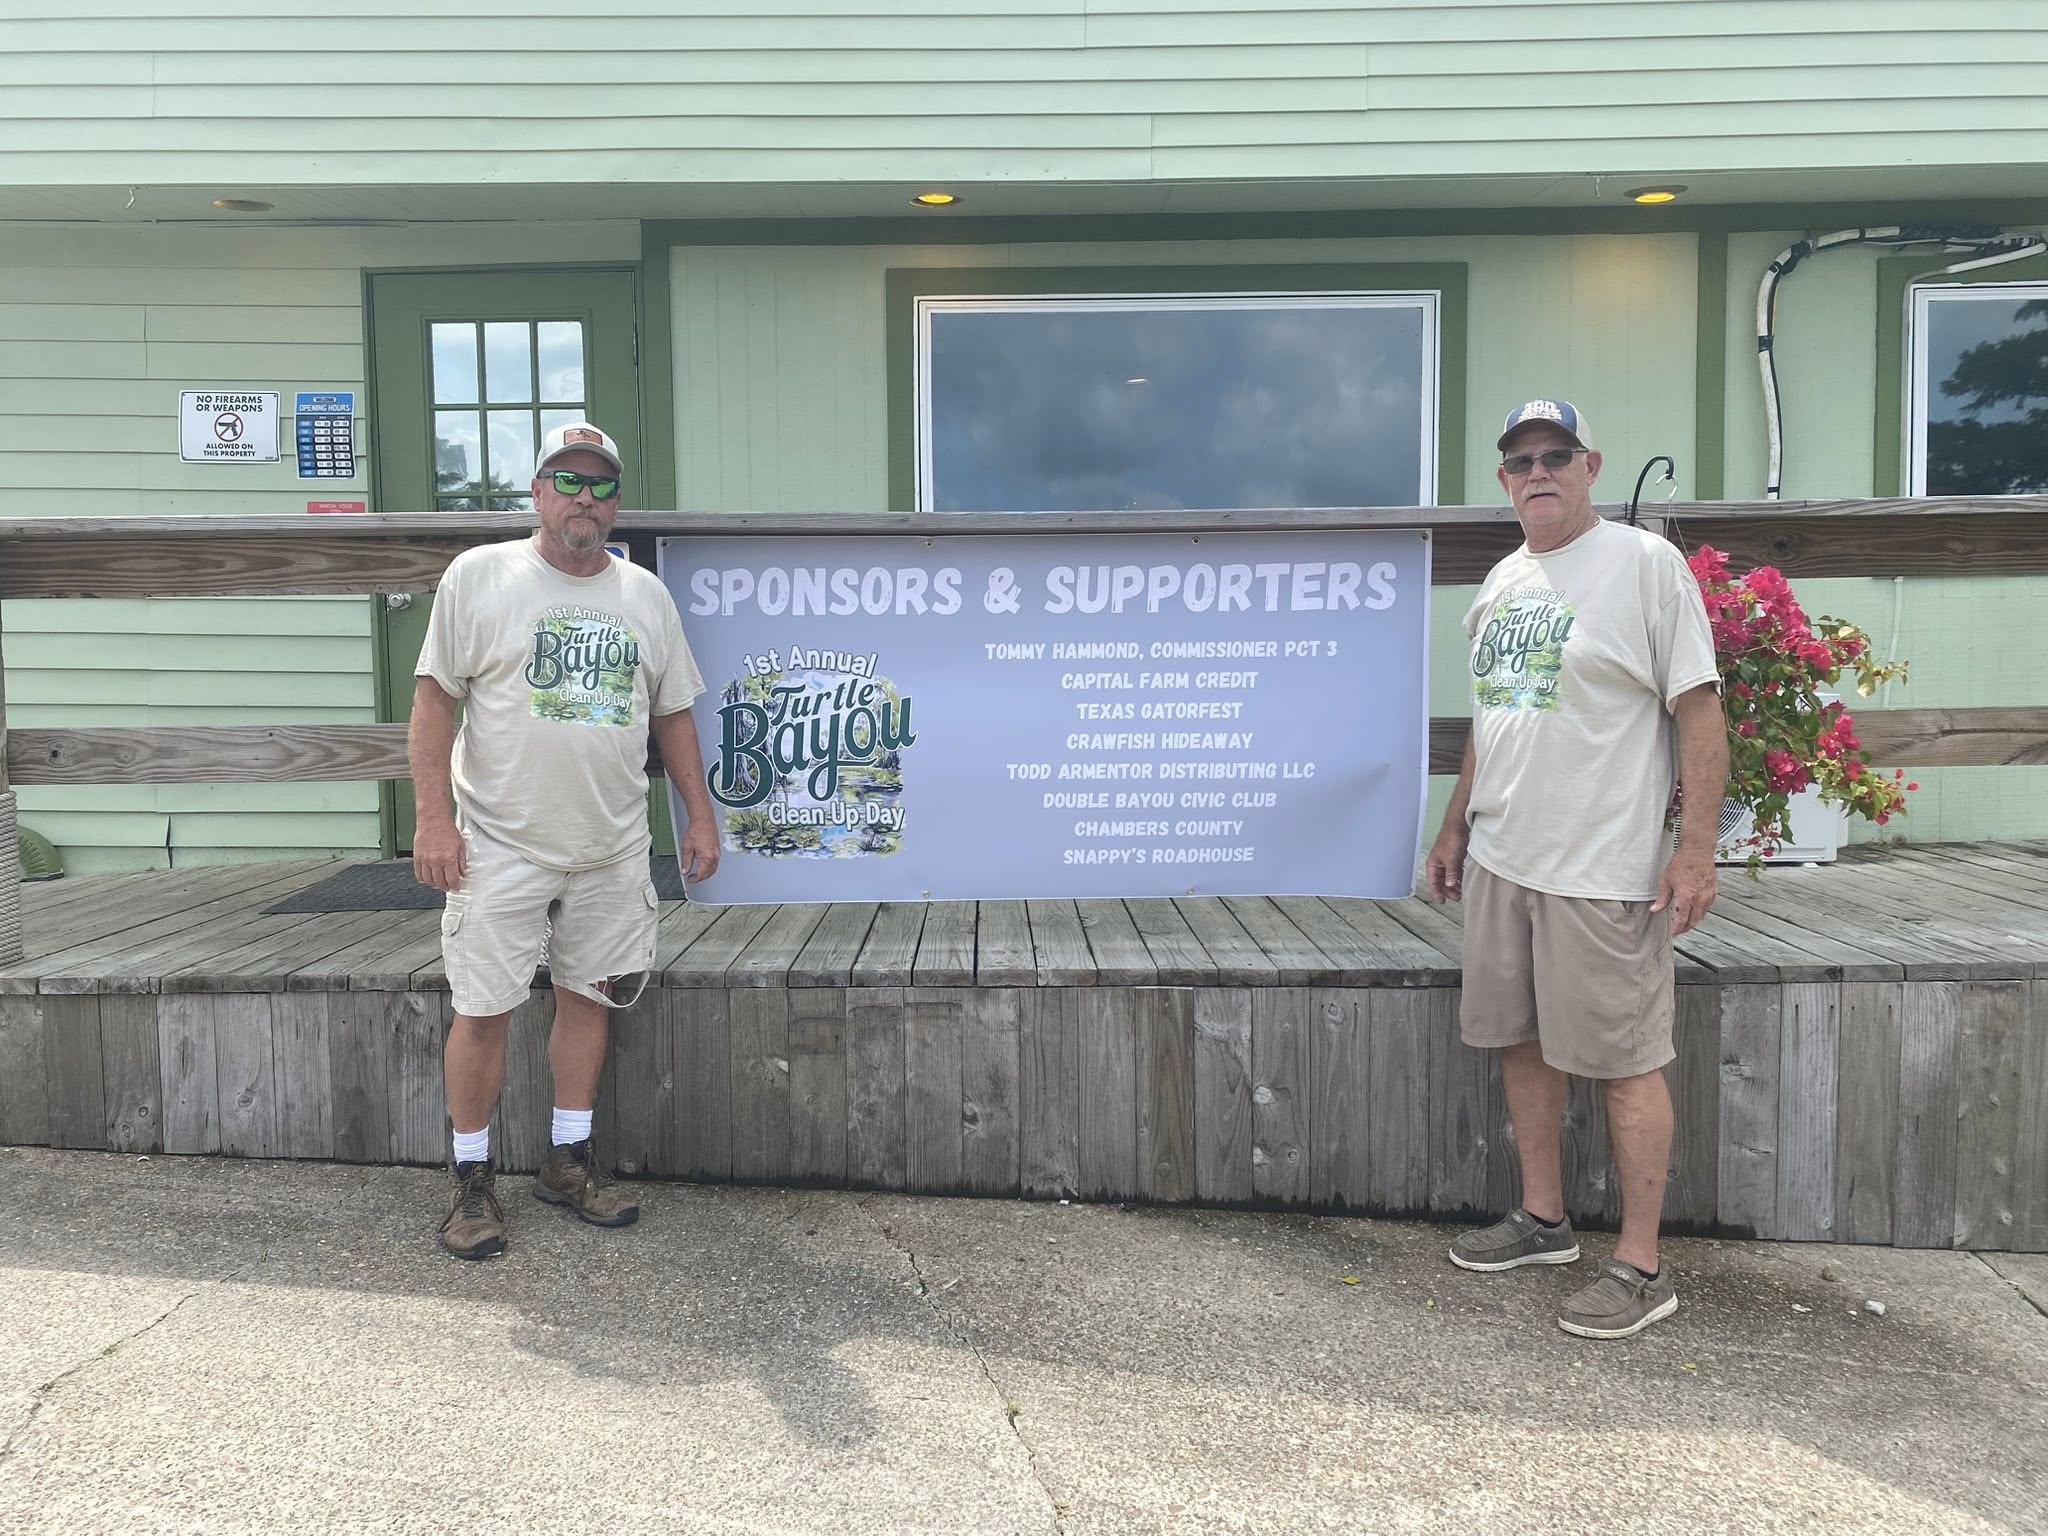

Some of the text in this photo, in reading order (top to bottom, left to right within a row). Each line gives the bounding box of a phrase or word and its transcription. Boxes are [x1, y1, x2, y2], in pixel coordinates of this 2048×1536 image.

[195, 403, 263, 412] OR WEAPONS
[196, 395, 263, 404] NO FIREARMS
[299, 404, 351, 412] OPENING HOURS
[689, 562, 1398, 616] SPONSORS & SUPPORTERS
[1516, 585, 1566, 605] Annual
[547, 606, 622, 628] 1st Annual
[1501, 603, 1556, 630] Turtle
[563, 626, 621, 647] Turtle
[985, 640, 1338, 660] TOMMY HAMMOND, COMMISSIONER PCT 3
[1472, 616, 1575, 678] Bayou
[525, 630, 640, 691] Bayou
[743, 645, 878, 679] 1st Annual
[1061, 671, 1258, 689] CAPITAL FARM CREDIT
[1490, 673, 1516, 689] Clean
[1519, 674, 1532, 693] Up
[559, 688, 631, 712] Clean Up Day
[770, 678, 874, 726] Turtle
[1077, 702, 1243, 720] TEXAS GATORFEST
[1066, 732, 1254, 750] CRAWFISH HIDEAWAY
[707, 696, 918, 809] Bayou
[1006, 762, 1316, 780] TODD ARMENTOR DISTRIBUTING LLC
[1043, 791, 1277, 809] DOUBLE BAYOU CIVIC CLUB
[768, 801, 906, 831] Clean Up Day
[1074, 820, 1244, 837] CHAMBERS COUNTY
[1064, 847, 1254, 864] SNAPPY'S ROADHOUSE
